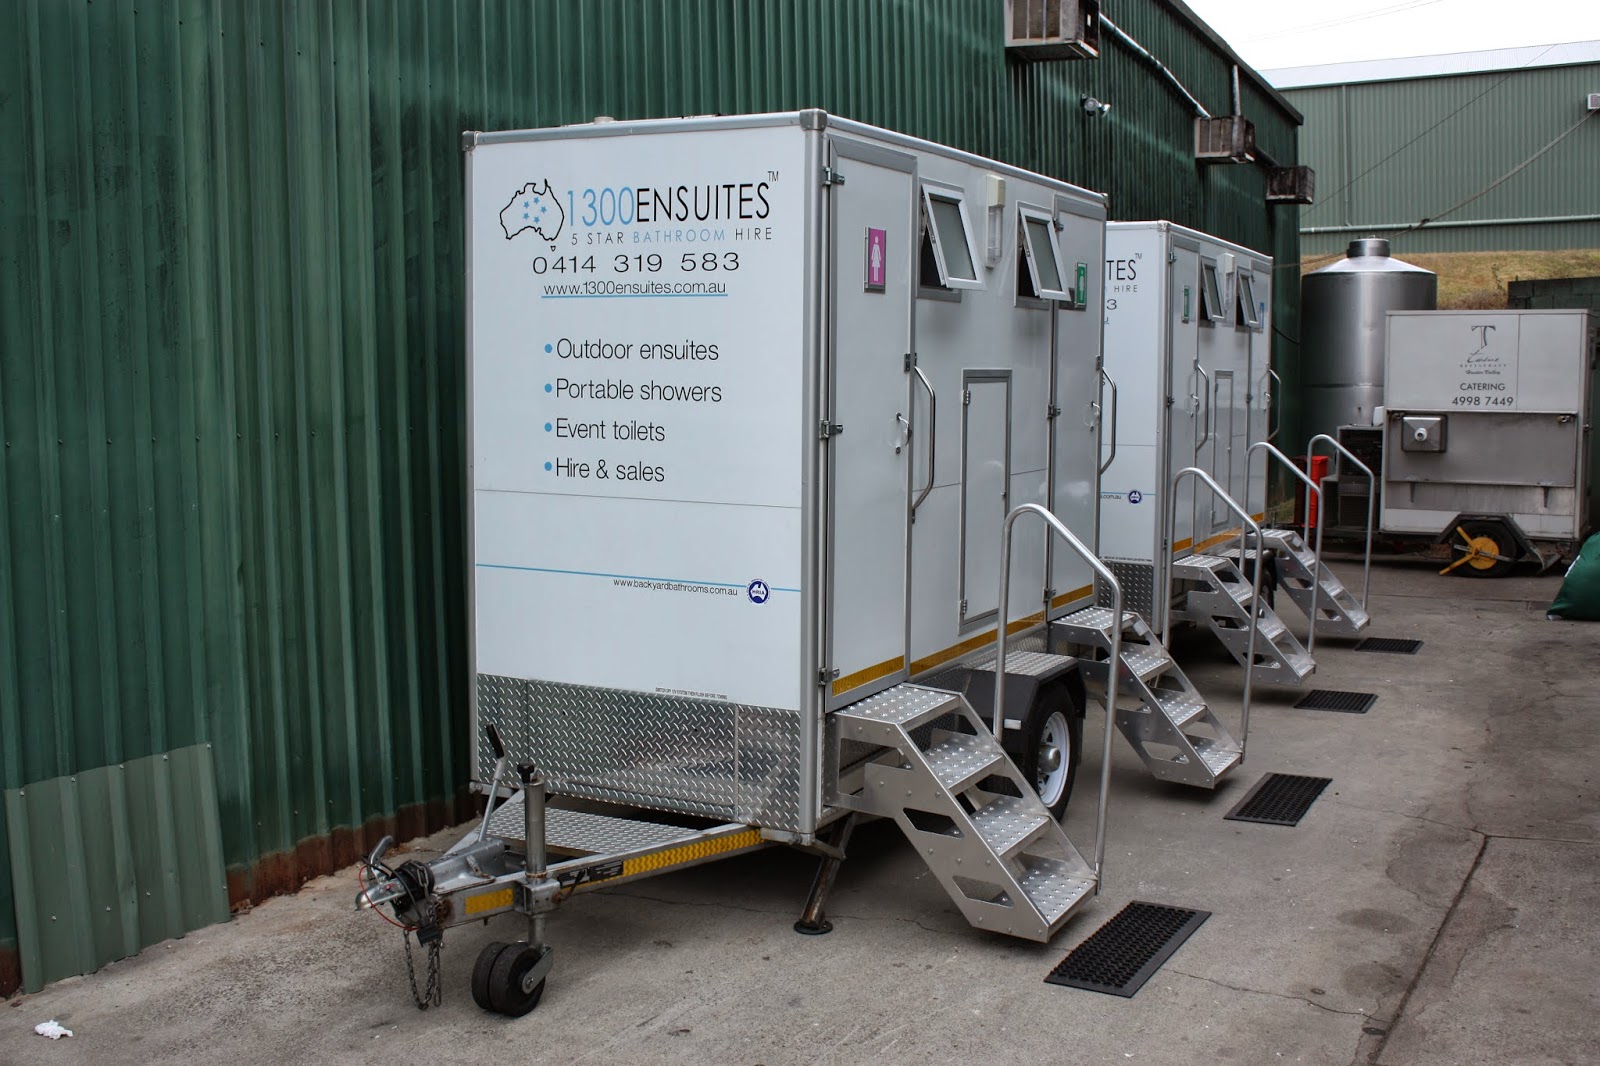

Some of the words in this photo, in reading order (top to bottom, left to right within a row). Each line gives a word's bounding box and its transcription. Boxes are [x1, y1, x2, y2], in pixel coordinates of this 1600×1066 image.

[567, 182, 770, 226] 1300ENSUITES
[572, 233, 578, 245] 5
[587, 232, 624, 244] STAR
[633, 228, 725, 243] BATHROOM
[735, 227, 772, 241] HIRE
[533, 256, 596, 274] 0414
[613, 254, 663, 273] 319
[681, 252, 740, 271] 583
[544, 281, 726, 295] www.1300ensuites.com.au
[1113, 284, 1138, 293] HIRE
[556, 338, 632, 359] Outdoor
[640, 340, 719, 360] ensuites
[556, 378, 633, 400] Portable
[640, 380, 722, 402] showers
[1452, 397, 1480, 405] 4998
[1485, 397, 1513, 406] 7449
[556, 418, 605, 439] Event
[613, 420, 665, 441] toilets
[556, 458, 590, 478] Hire
[596, 460, 609, 480] &
[616, 461, 664, 482] sales
[613, 579, 738, 596] www.backyardbathrooms.com.au
